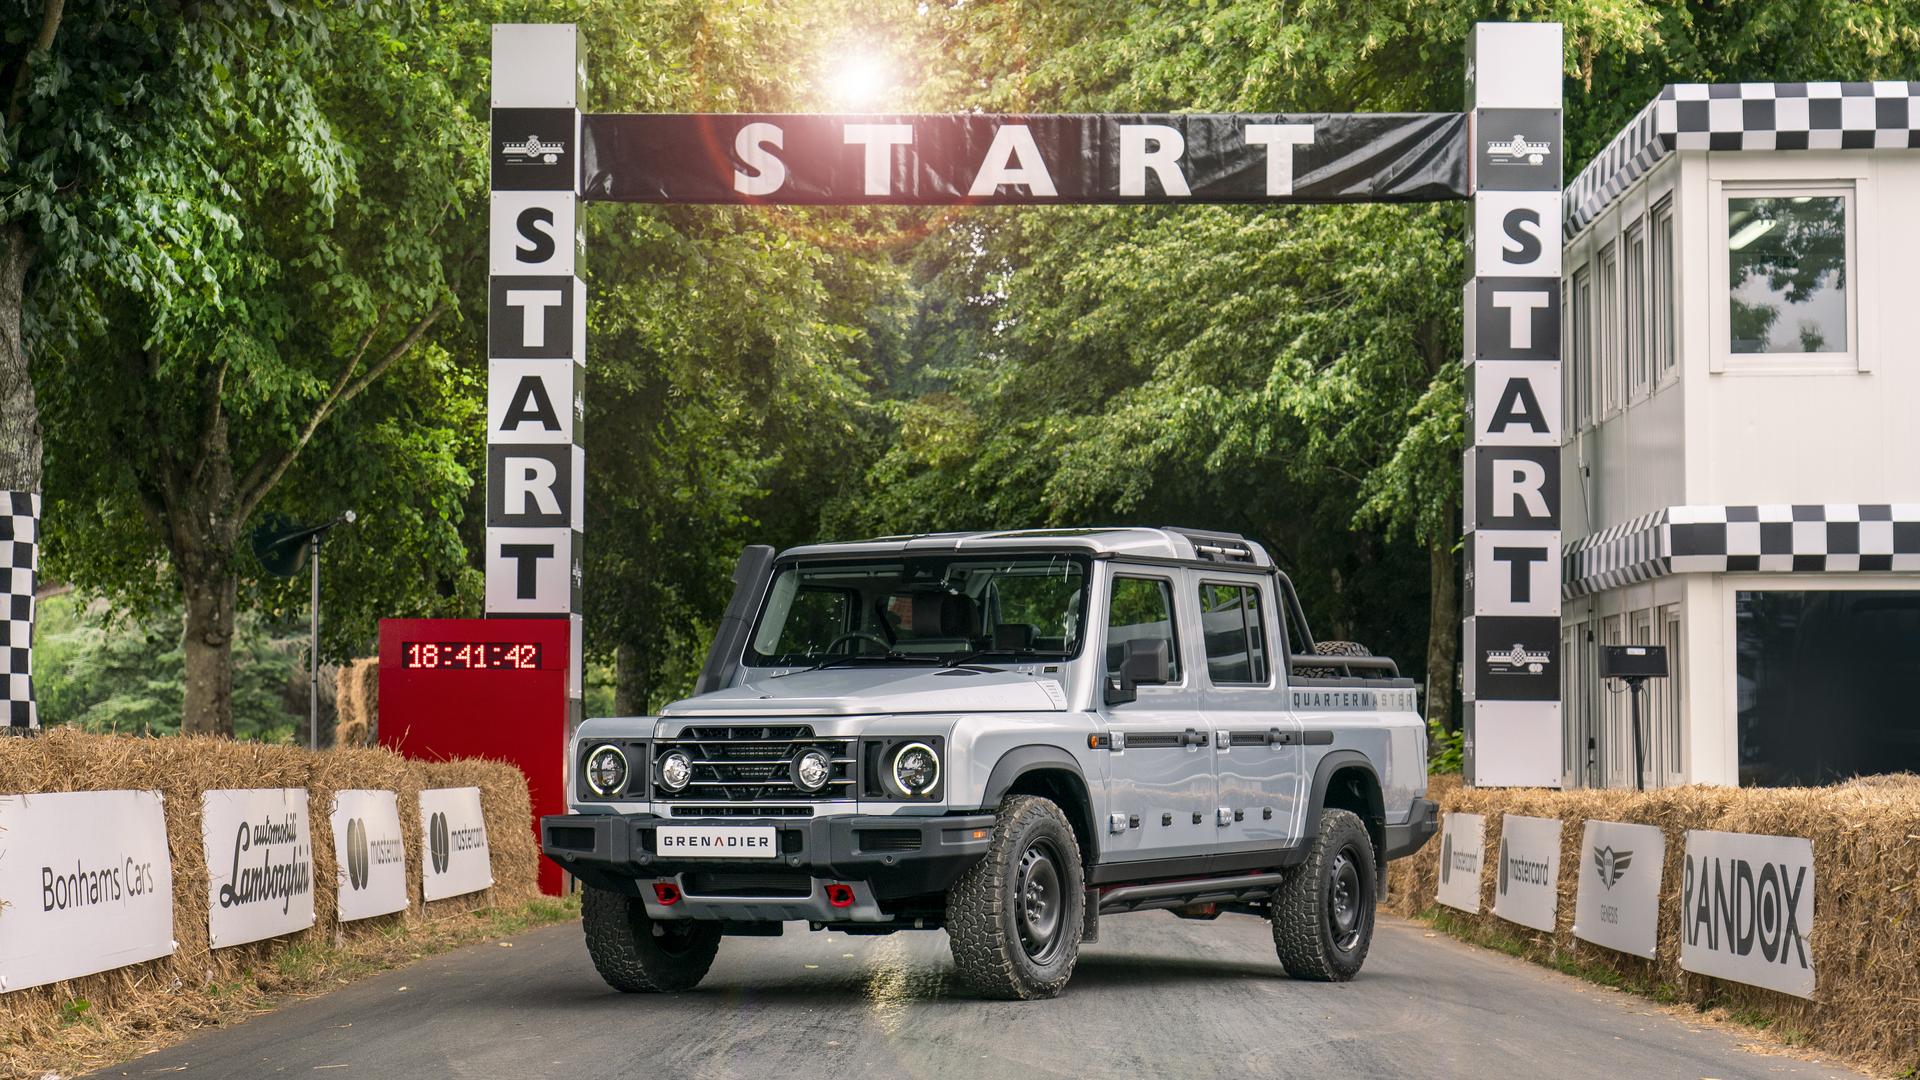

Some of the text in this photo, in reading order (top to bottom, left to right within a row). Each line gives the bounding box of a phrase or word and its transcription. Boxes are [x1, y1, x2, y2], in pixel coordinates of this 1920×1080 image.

[733, 122, 1315, 197] START
[499, 207, 562, 600] START
[1486, 208, 1551, 603] START
[409, 644, 536, 668] 18:41:42
[1293, 692, 1413, 708] QUARTERMASTER
[253, 813, 297, 846] automobili
[664, 836, 769, 847] GRENADIER
[42, 856, 154, 912] Bonhams Cars
[219, 821, 310, 915] Lamborghini
[1510, 855, 1550, 886] mastercard
[1683, 854, 1808, 969] RANDOX
